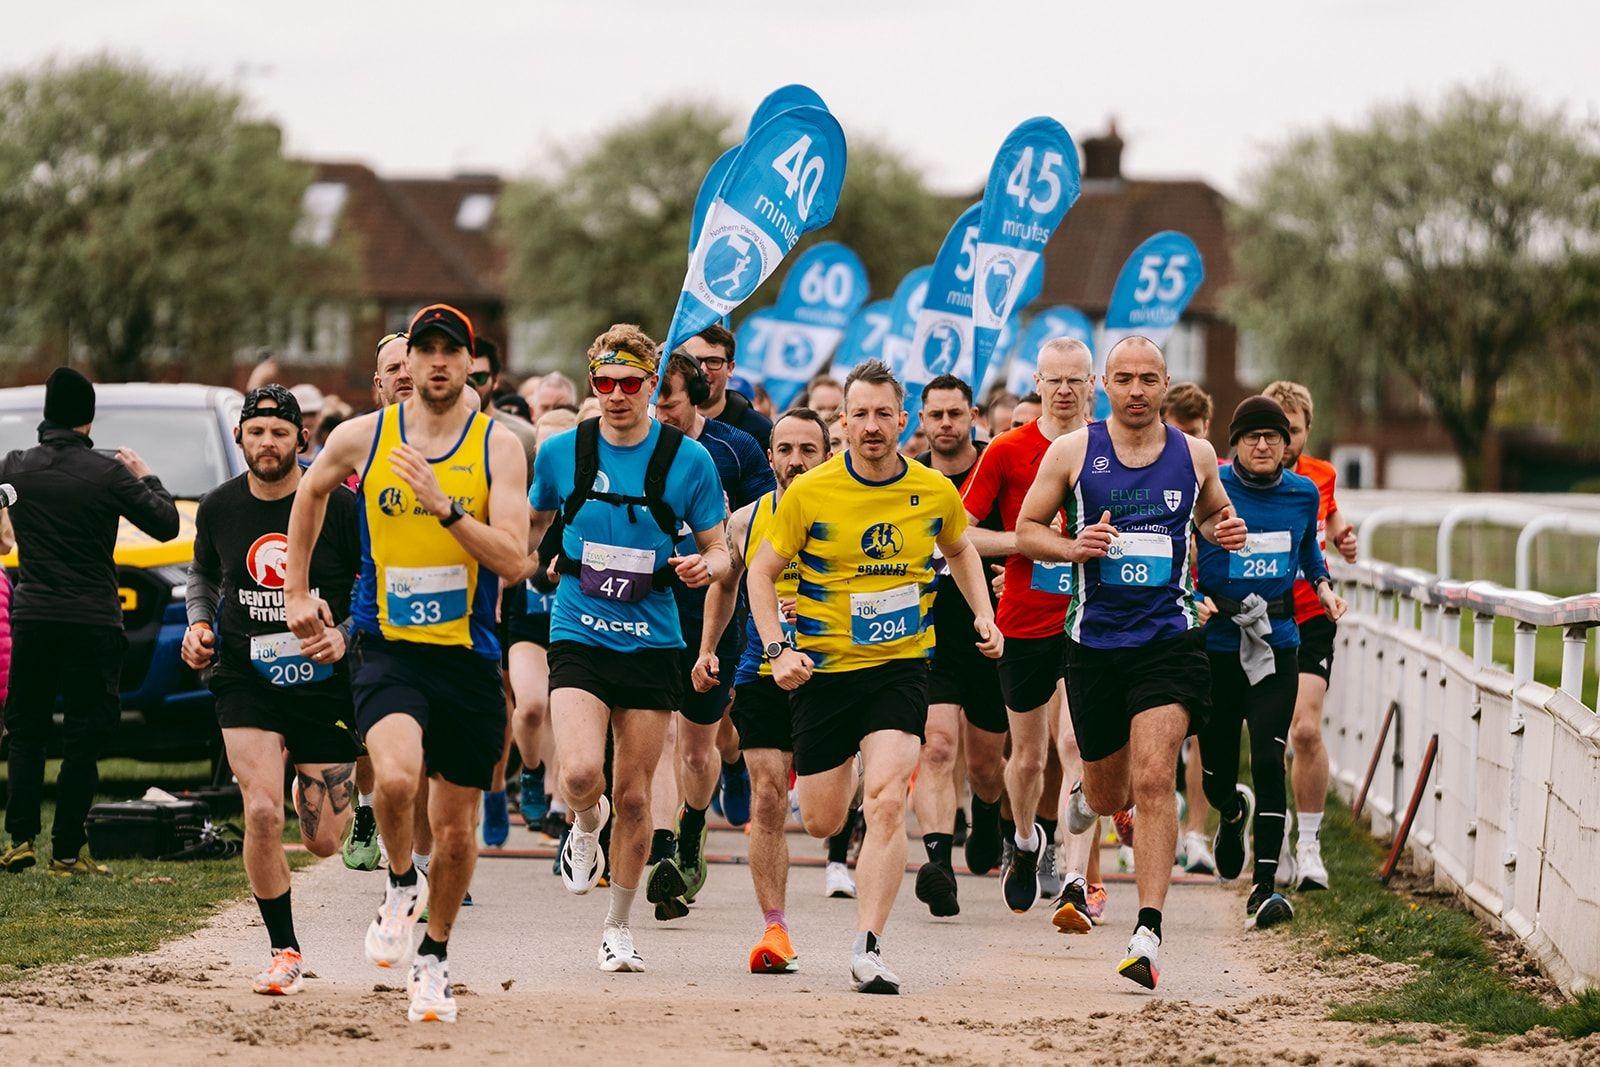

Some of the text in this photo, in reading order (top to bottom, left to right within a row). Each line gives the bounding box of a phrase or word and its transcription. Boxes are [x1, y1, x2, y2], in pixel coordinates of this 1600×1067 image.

[772, 134, 825, 222] 40
[1006, 146, 1063, 214] 45
[709, 224, 739, 238] Northern
[799, 260, 853, 308] 60
[1133, 254, 1190, 303] 55
[1110, 489, 1151, 501] ELVET
[1108, 546, 1124, 555] 0k
[1121, 563, 1148, 583] 68
[1243, 559, 1278, 577] 284
[391, 583, 411, 593] 10k
[600, 577, 630, 598] 47
[1058, 573, 1071, 592] 5
[239, 588, 320, 607] CENTUN
[410, 600, 442, 624] 33
[857, 605, 878, 616] 10k
[580, 614, 651, 637] PACER
[869, 616, 907, 641] 294
[256, 648, 277, 659] 10k
[269, 662, 314, 685] 209
